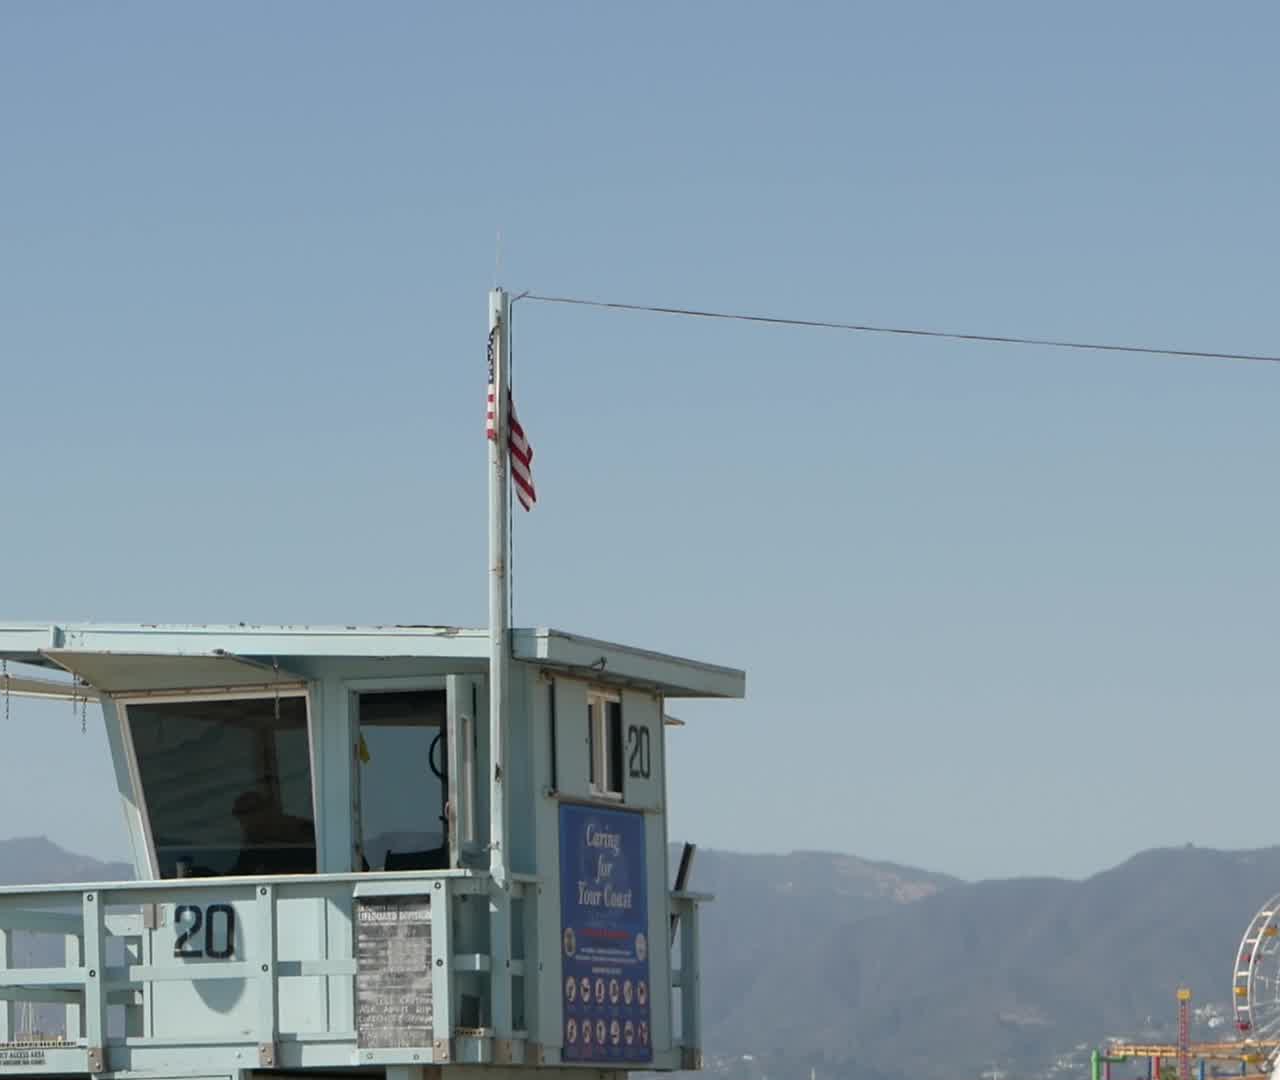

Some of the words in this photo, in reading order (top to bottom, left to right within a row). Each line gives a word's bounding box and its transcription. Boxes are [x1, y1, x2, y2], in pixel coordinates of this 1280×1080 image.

[628, 725, 650, 779] 20
[585, 824, 619, 856] Caring
[595, 855, 612, 883] for
[577, 880, 601, 905] Your
[604, 885, 632, 909] Coast
[174, 904, 235, 959] 20
